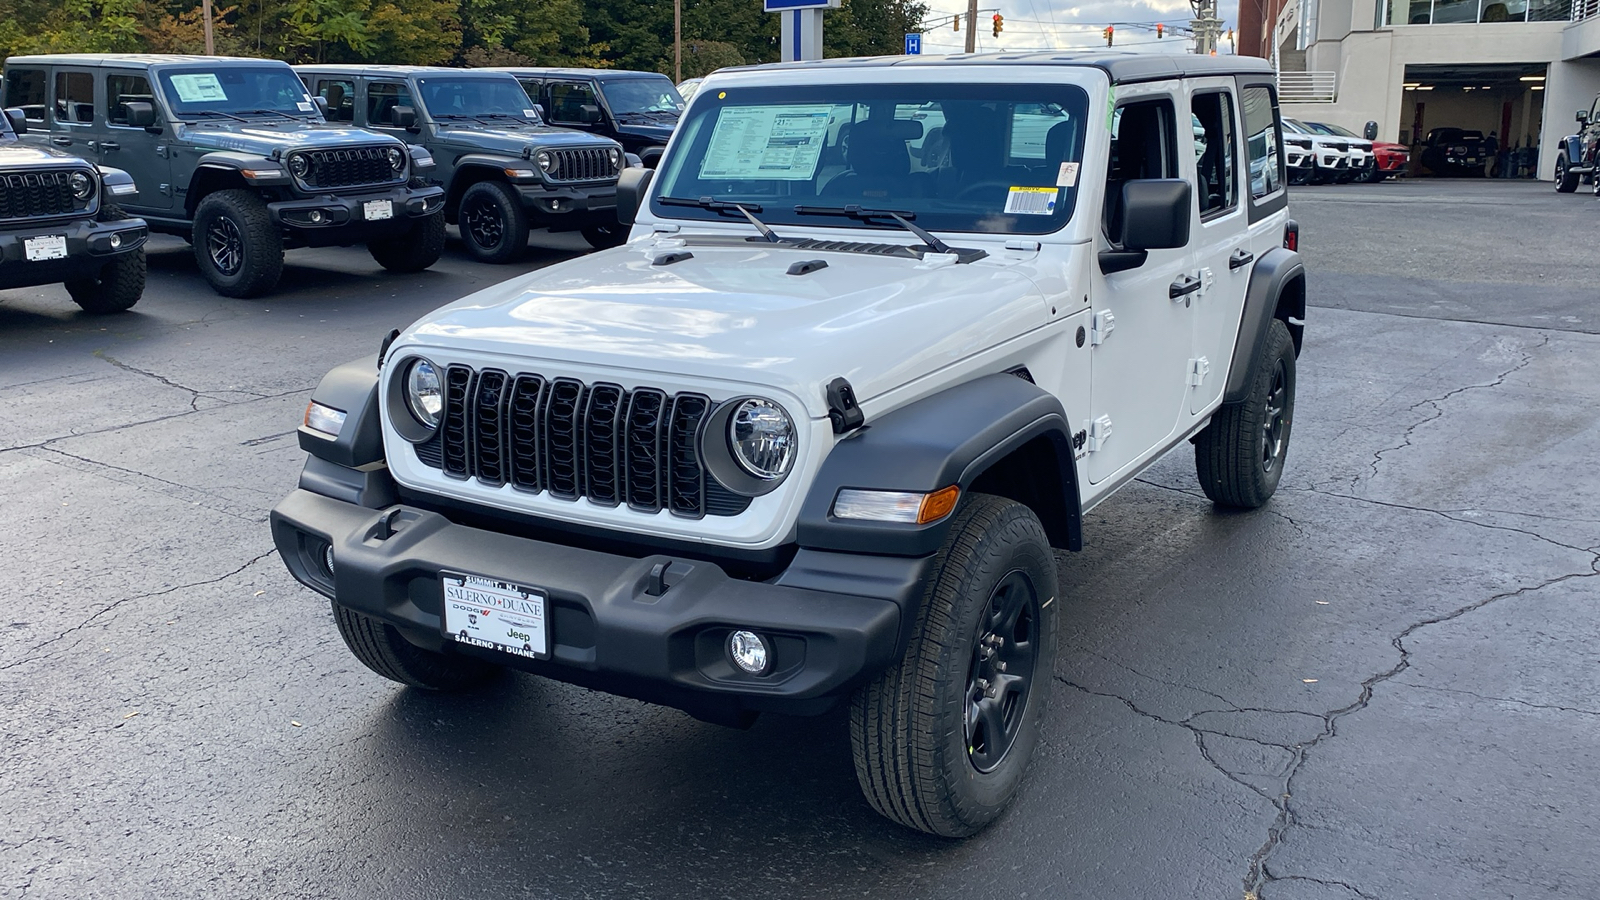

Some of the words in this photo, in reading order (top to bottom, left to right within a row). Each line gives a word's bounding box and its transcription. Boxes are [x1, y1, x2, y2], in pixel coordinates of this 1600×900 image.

[909, 39, 918, 51] H
[506, 584, 518, 592] NJ
[447, 586, 497, 606] SALERNO
[503, 598, 542, 616] DUANE
[507, 628, 530, 642] Jeep
[455, 635, 494, 649] SALERNO
[506, 646, 535, 659] DUANE
